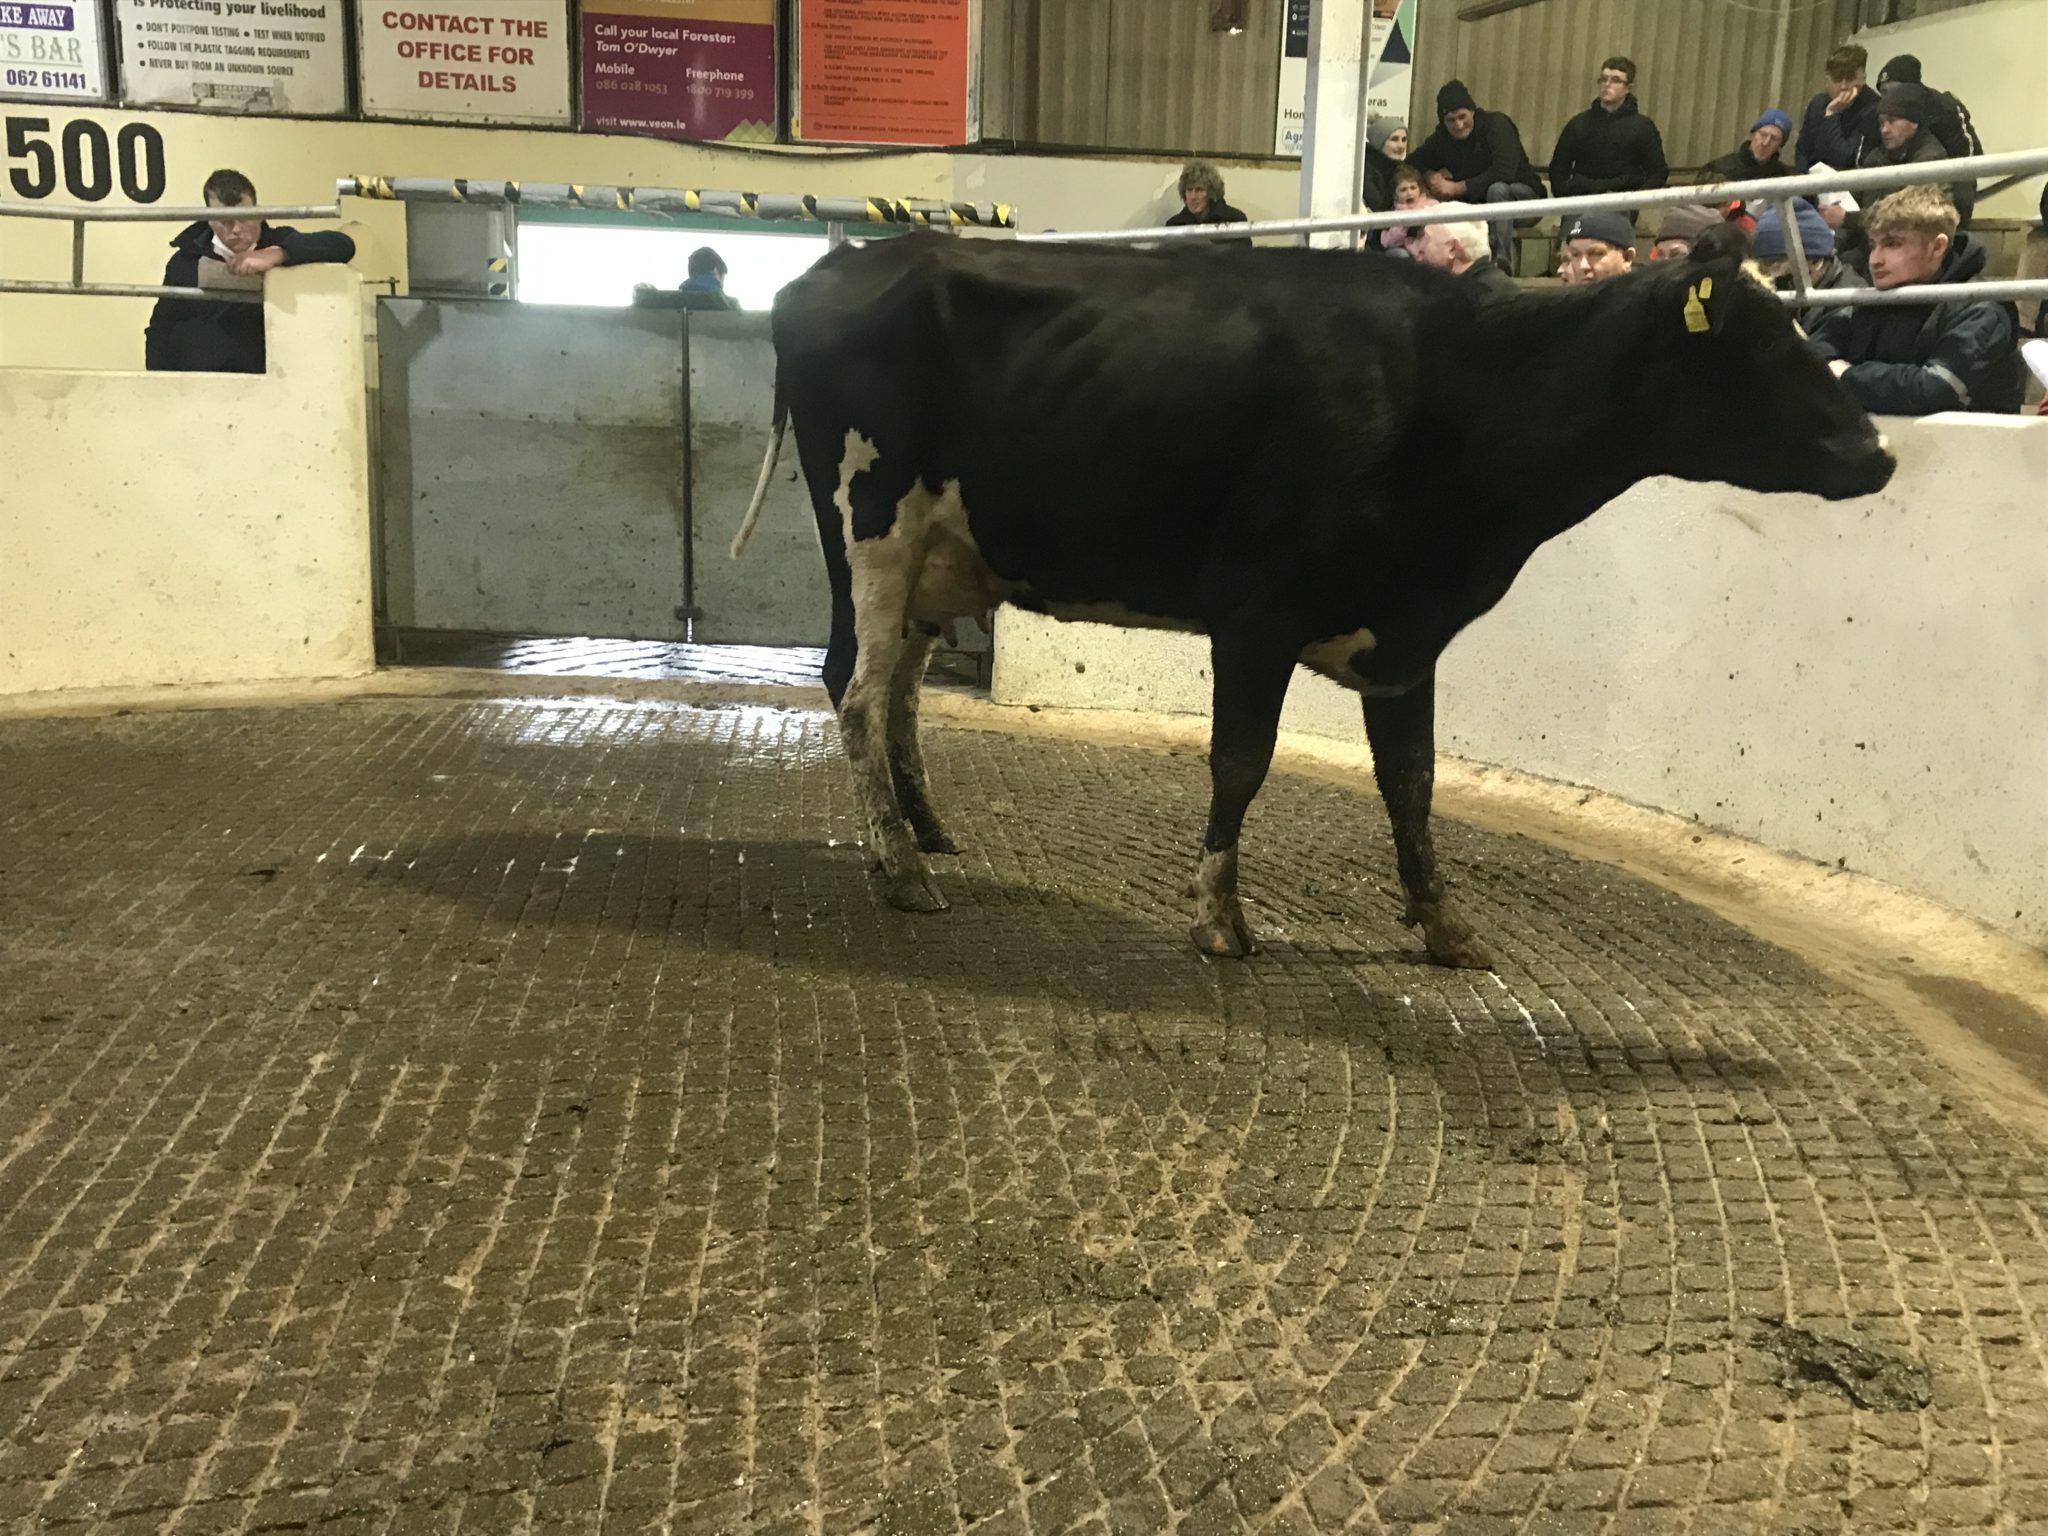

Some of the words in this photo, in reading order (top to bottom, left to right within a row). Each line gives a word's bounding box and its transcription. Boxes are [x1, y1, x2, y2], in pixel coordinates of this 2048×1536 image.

[0, 6, 22, 24] KE
[28, 8, 65, 27] AWAY
[150, 0, 221, 15] Protecting
[226, 3, 256, 16] your
[261, 2, 326, 18] livelihood
[146, 22, 168, 32] DON'T
[171, 23, 209, 35] POSTPONE
[211, 26, 240, 37] TESTING
[382, 11, 495, 35] CONTACT
[500, 18, 549, 38] THE
[253, 29, 269, 39] TEST
[272, 30, 292, 41] WHEN
[295, 31, 326, 42] NOTIFIED
[594, 24, 618, 36] Call
[620, 27, 648, 40] your
[651, 27, 679, 40] local
[682, 30, 736, 44] Forester:
[32, 35, 82, 63] BAR
[147, 40, 177, 51] FOLLOW
[179, 42, 192, 52] THE
[194, 43, 222, 54] PLASTIC
[225, 45, 256, 56] TAGGING
[258, 47, 310, 59] REQUIREMENTS
[397, 40, 482, 62] OFFICE
[488, 46, 535, 65] FOR
[596, 40, 620, 53] Tom
[623, 42, 678, 58] O'Dwyer
[149, 58, 172, 69] NEVER
[175, 60, 189, 70] BUY
[191, 60, 212, 71] FROM
[214, 62, 225, 72] AN
[227, 63, 265, 74] UNKNOWN
[267, 65, 294, 76] SOURCE
[595, 62, 635, 75] Mobile
[685, 67, 744, 82] Freephone
[7, 69, 38, 87] 062
[42, 71, 86, 89] 61141
[418, 71, 517, 93] DETAILS
[595, 79, 618, 91] 086
[596, 116, 617, 127] visit
[619, 117, 686, 130] www.veon.ie
[5, 116, 166, 204] 500
